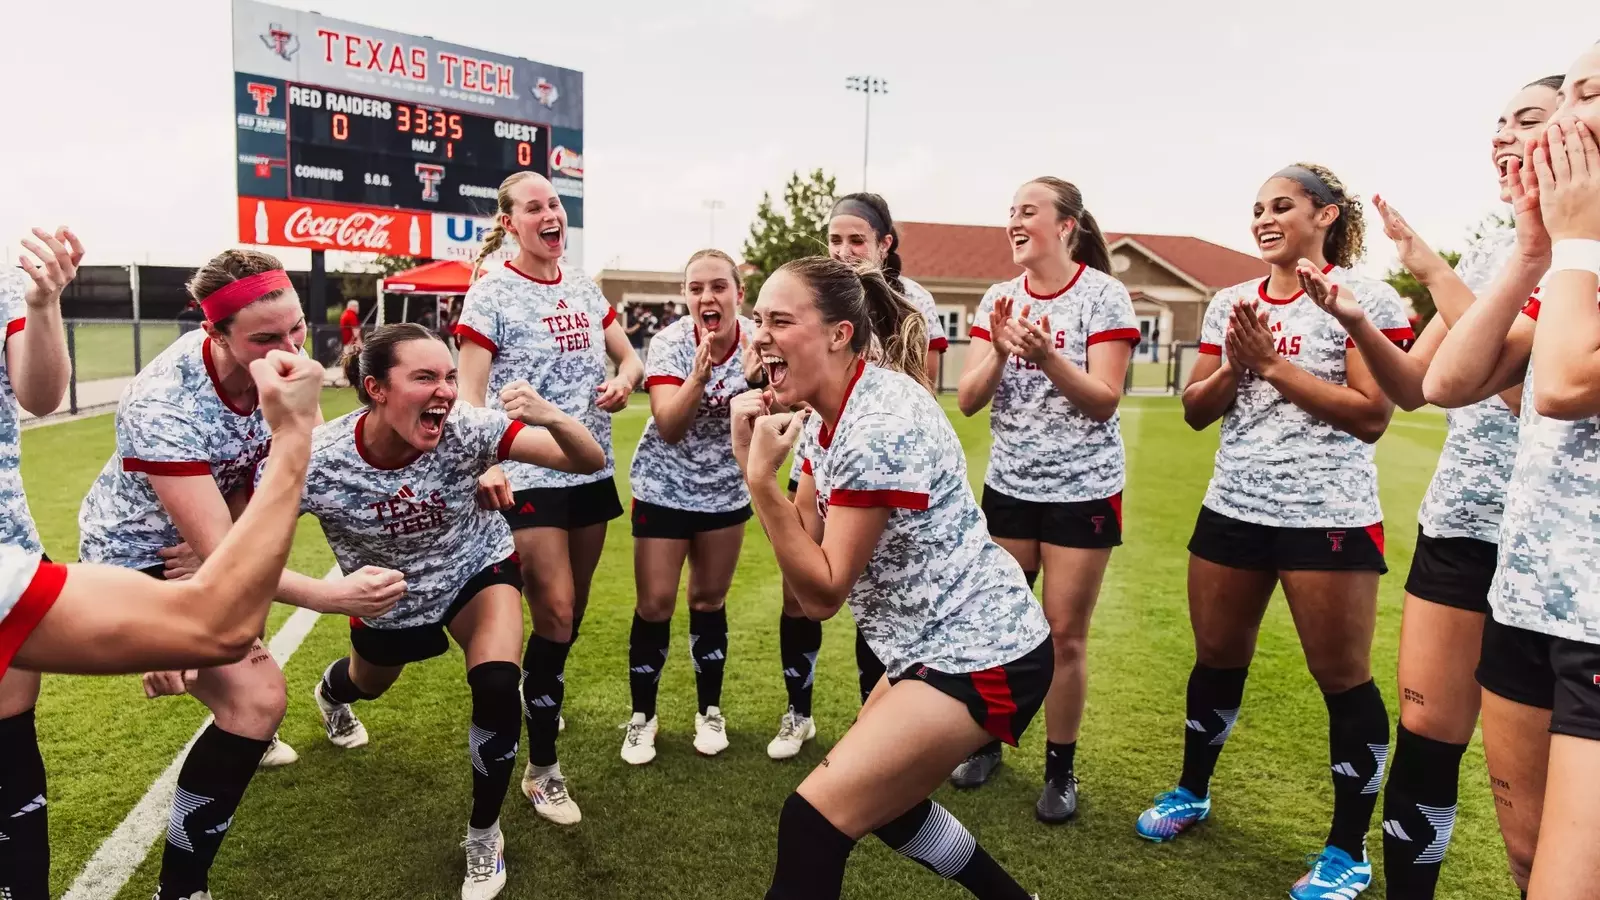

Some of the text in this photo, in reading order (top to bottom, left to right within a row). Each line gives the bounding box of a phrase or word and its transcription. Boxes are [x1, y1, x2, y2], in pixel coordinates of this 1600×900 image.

[317, 28, 514, 97] TEXAS TECH
[289, 86, 392, 120] RED RAIDERS
[332, 113, 349, 141] 0
[396, 103, 463, 140] 33:35
[494, 120, 538, 143] GUEST
[411, 138, 454, 159] HALF 1
[517, 141, 532, 166] 0
[294, 163, 344, 182] CORNERS
[284, 206, 396, 250] Coca-Cola
[542, 312, 590, 334] TEXAS
[555, 331, 591, 353] TECH
[369, 490, 447, 521] TEXAS
[383, 511, 444, 539] TECH
